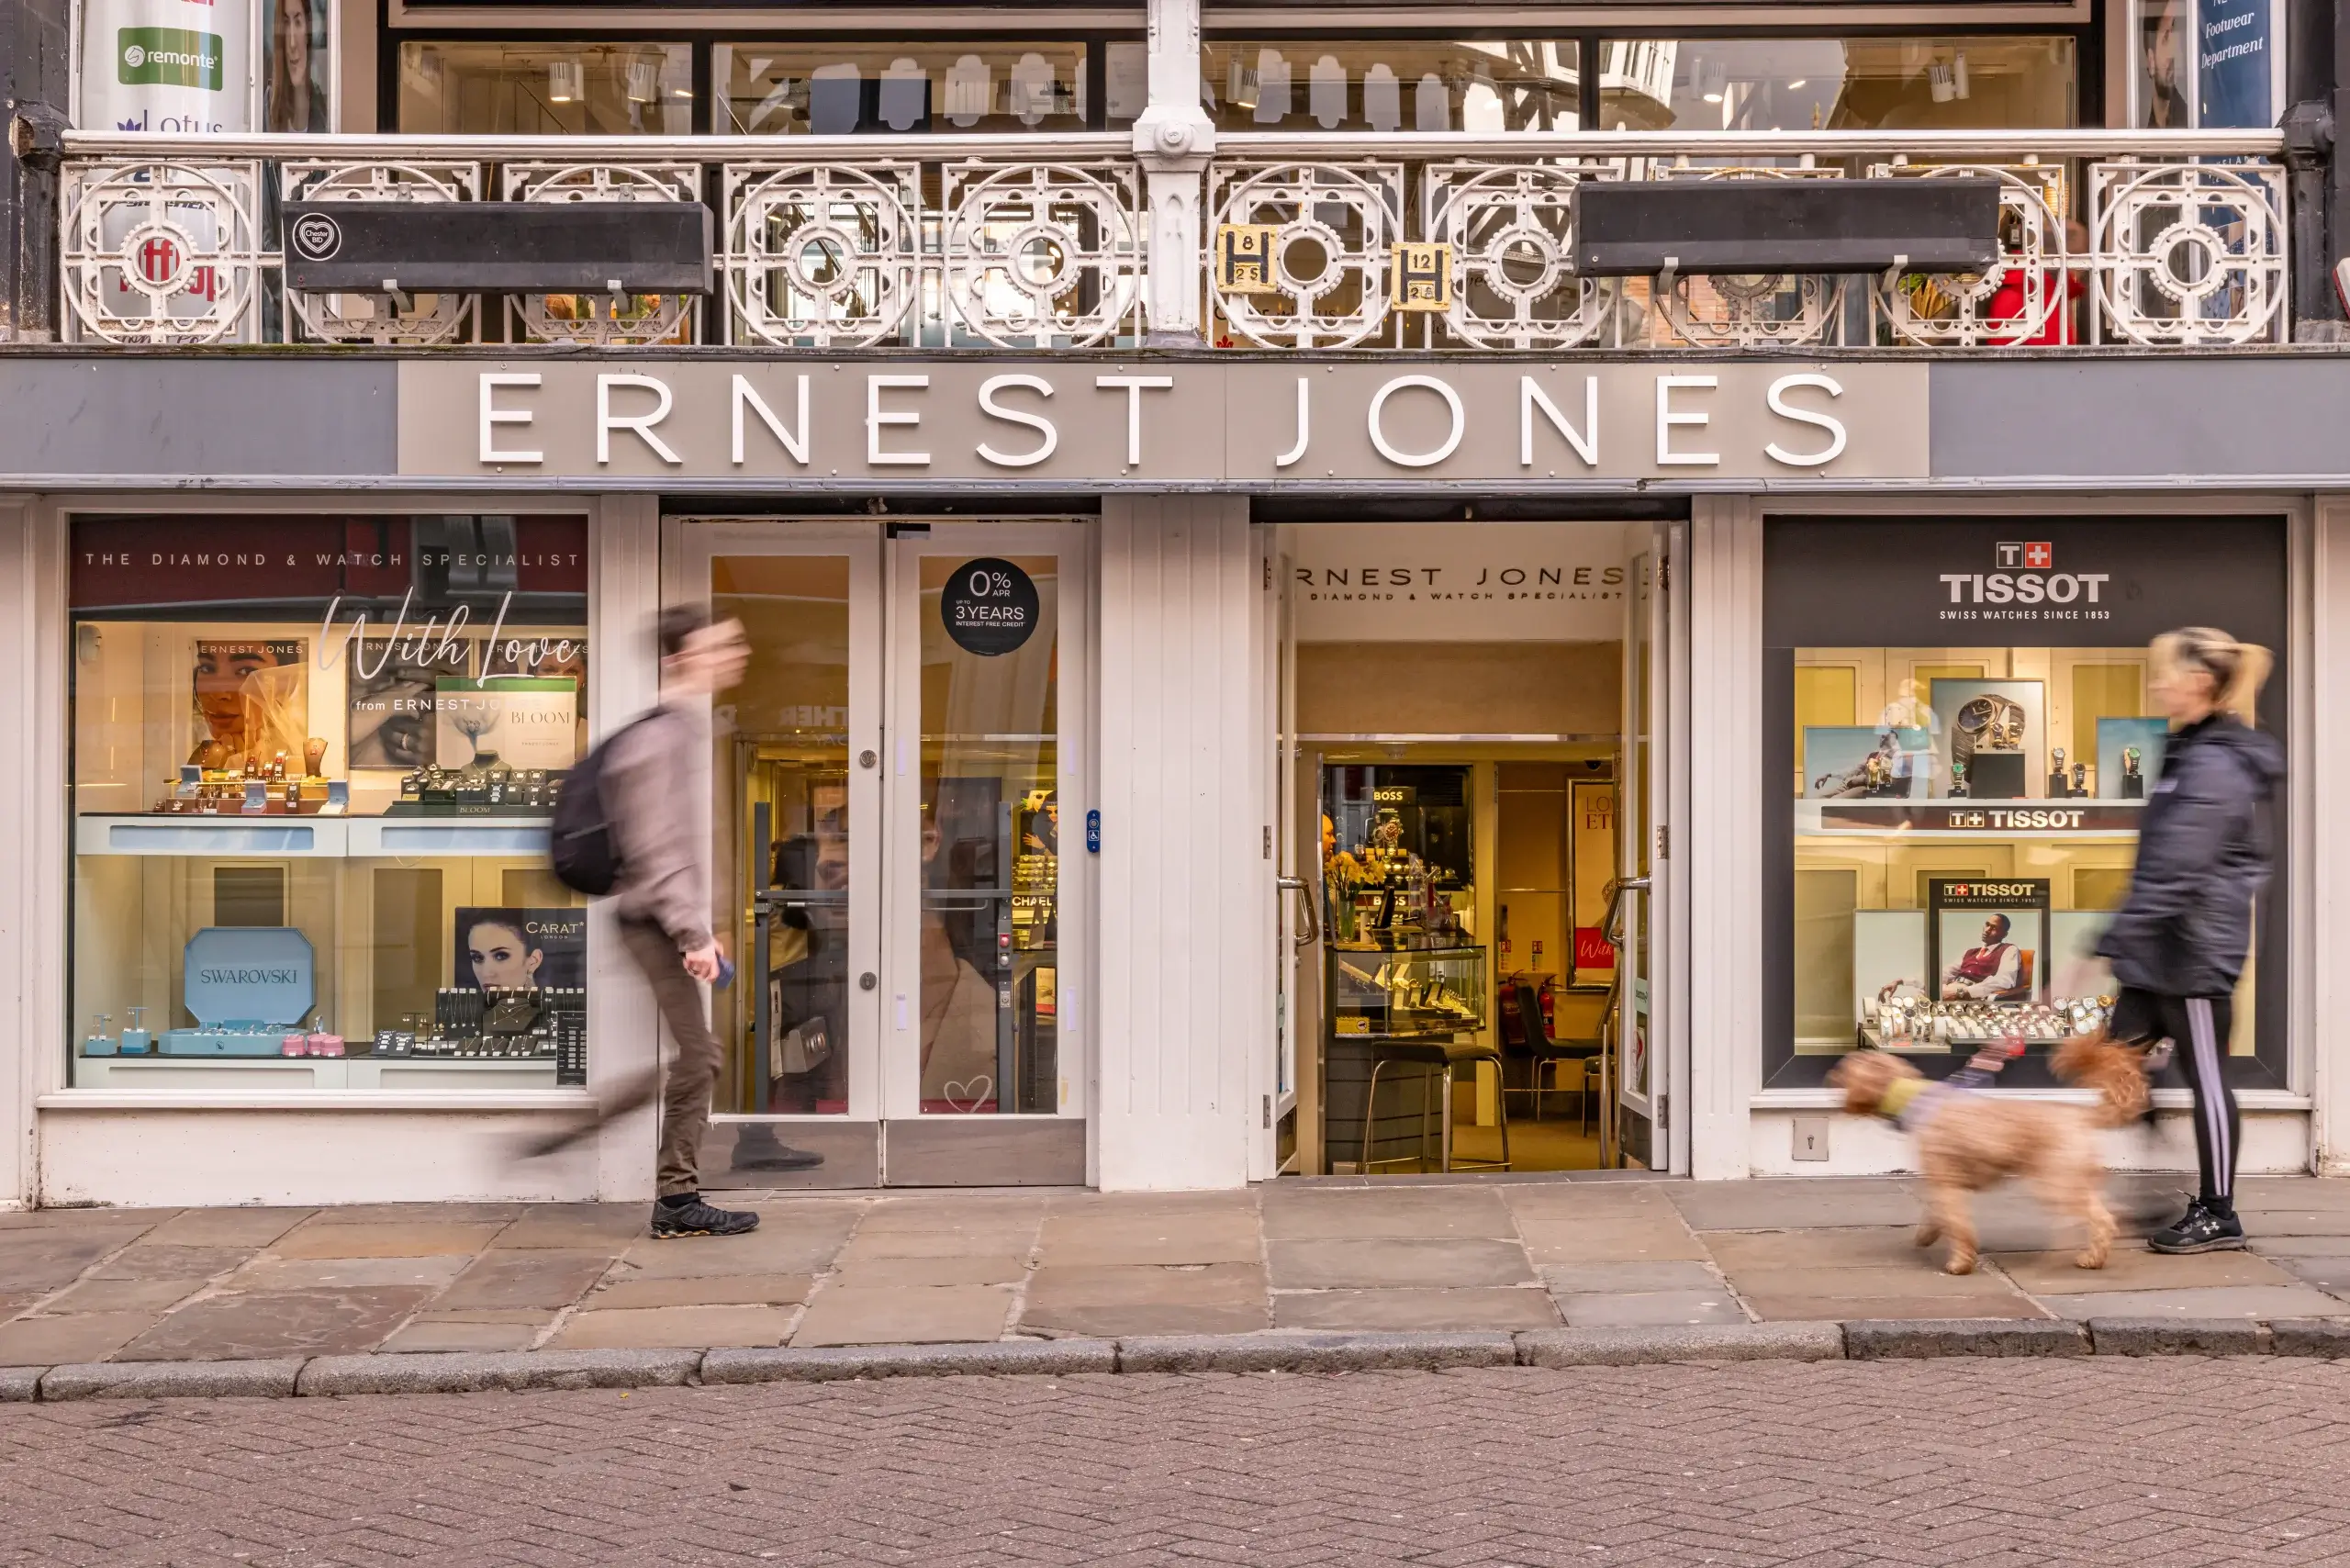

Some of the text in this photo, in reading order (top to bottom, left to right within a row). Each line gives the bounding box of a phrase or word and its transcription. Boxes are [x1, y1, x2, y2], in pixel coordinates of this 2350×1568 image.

[2205, 12, 2255, 39] Footwear
[2201, 36, 2264, 70] Department
[1242, 235, 1254, 251] 8
[1413, 253, 1431, 269] 12
[479, 373, 1846, 466] ERNEST JONES
[85, 554, 577, 566] THE DIAMOND & WATCH SPECIALIST
[969, 570, 1012, 597] 0%
[1296, 567, 1624, 586] RNEST JONES
[1310, 592, 1394, 601] DIAMOND
[1431, 592, 1493, 601] WATCH
[1508, 591, 1623, 601] SPECIALIST
[1940, 573, 2109, 603] TISSOT
[956, 606, 1024, 620] 3 YEARS
[1940, 610, 2110, 620] SWISS WATCHES SINCE 1853
[318, 586, 580, 689] With Love
[201, 645, 304, 654] ERNEST JONES
[356, 699, 386, 711] from
[394, 699, 470, 711] ERNEST
[511, 711, 569, 724] BLOOM
[1373, 791, 1404, 801] BOSS
[1586, 813, 1614, 830] ET
[1988, 810, 2084, 828] TISSOT
[1968, 884, 2035, 896] TISSOT
[1012, 896, 1053, 906] CHAEL
[1581, 938, 1613, 958] With
[200, 969, 298, 984] SWAROVSKI
